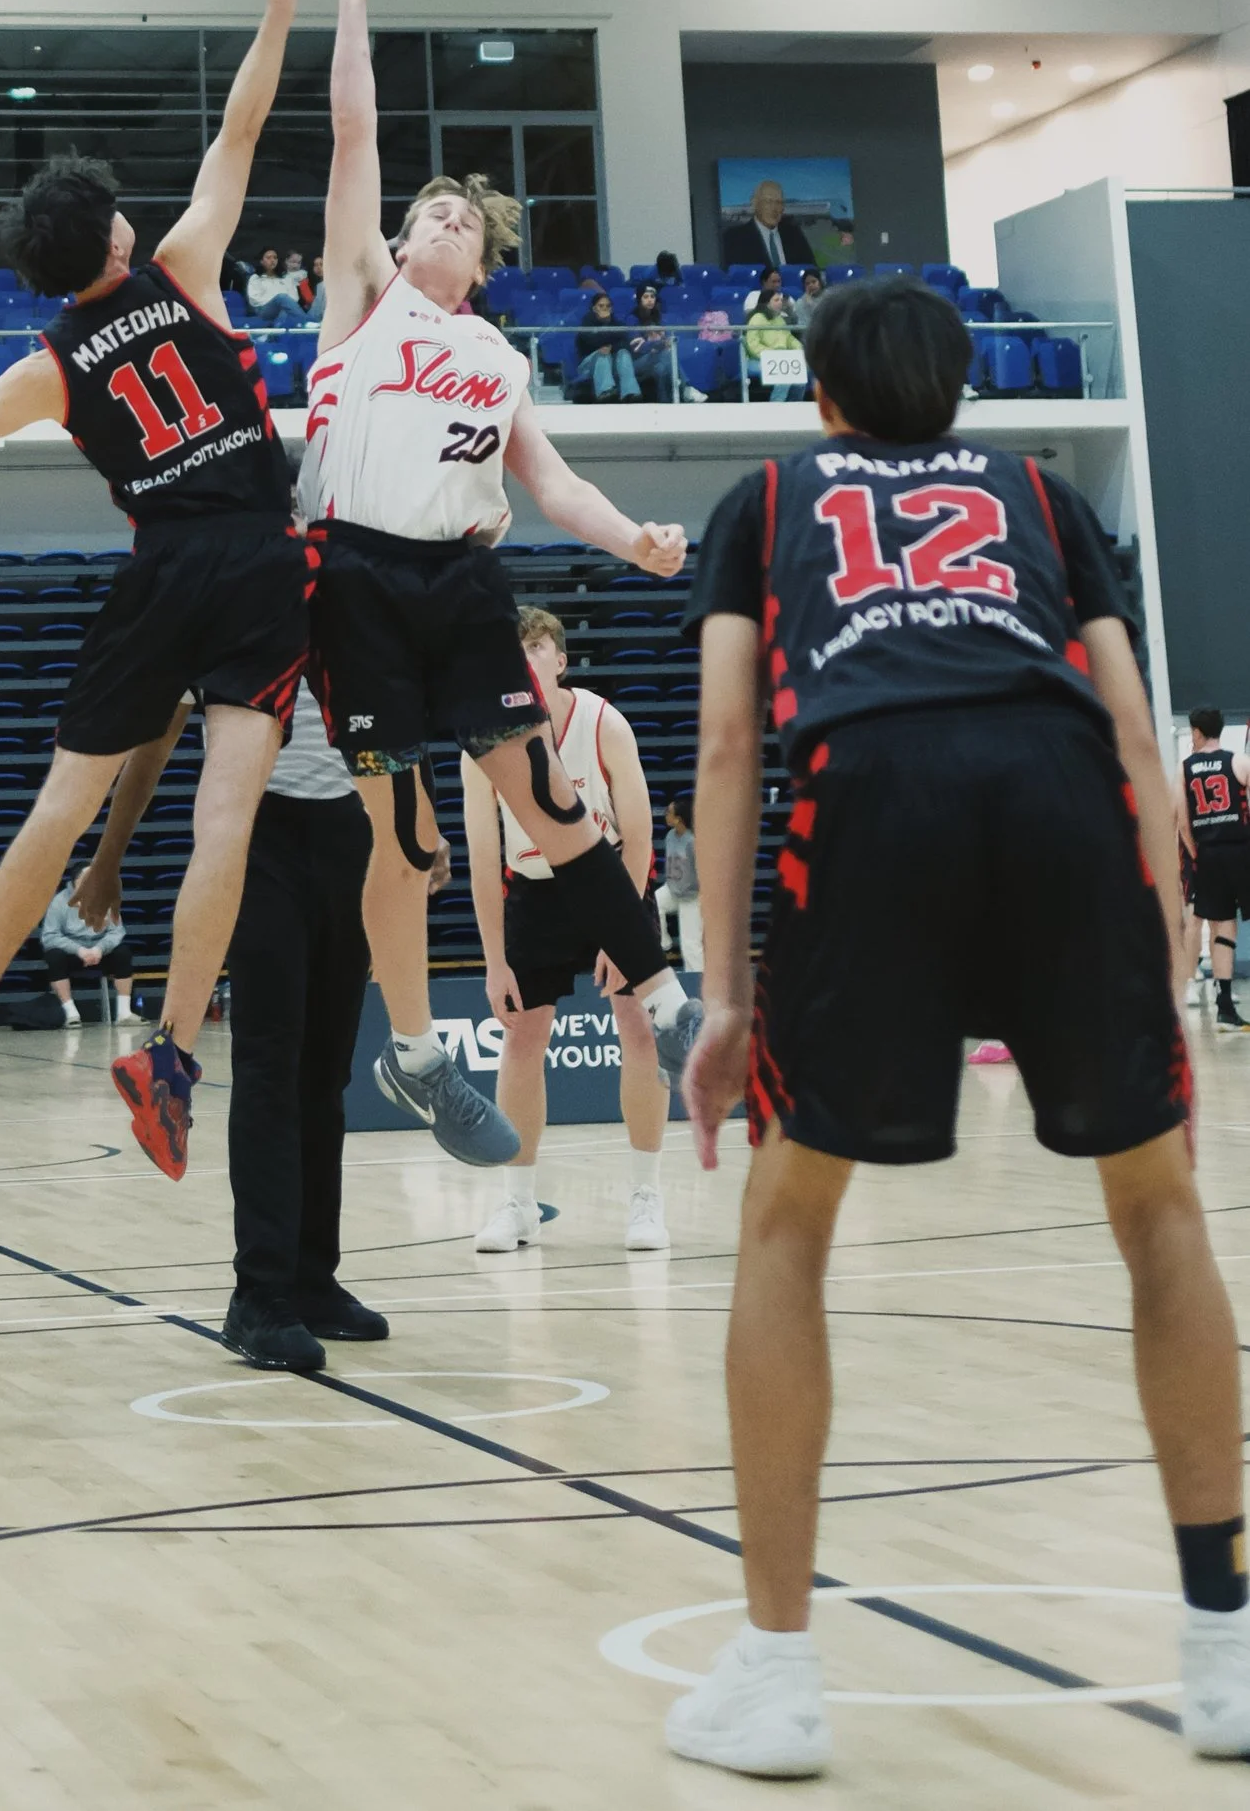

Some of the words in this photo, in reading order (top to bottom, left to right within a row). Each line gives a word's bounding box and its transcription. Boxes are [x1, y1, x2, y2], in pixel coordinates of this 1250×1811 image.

[71, 300, 190, 374] MATEOHIA
[368, 337, 512, 412] Slam
[767, 359, 802, 376] 209
[108, 340, 224, 461] 11
[438, 421, 501, 464] 20
[814, 483, 1019, 607] 12
[349, 715, 374, 732] SAS
[1191, 775, 1231, 815] 13
[432, 1017, 505, 1072] AS
[545, 1044, 622, 1069] YOUR
